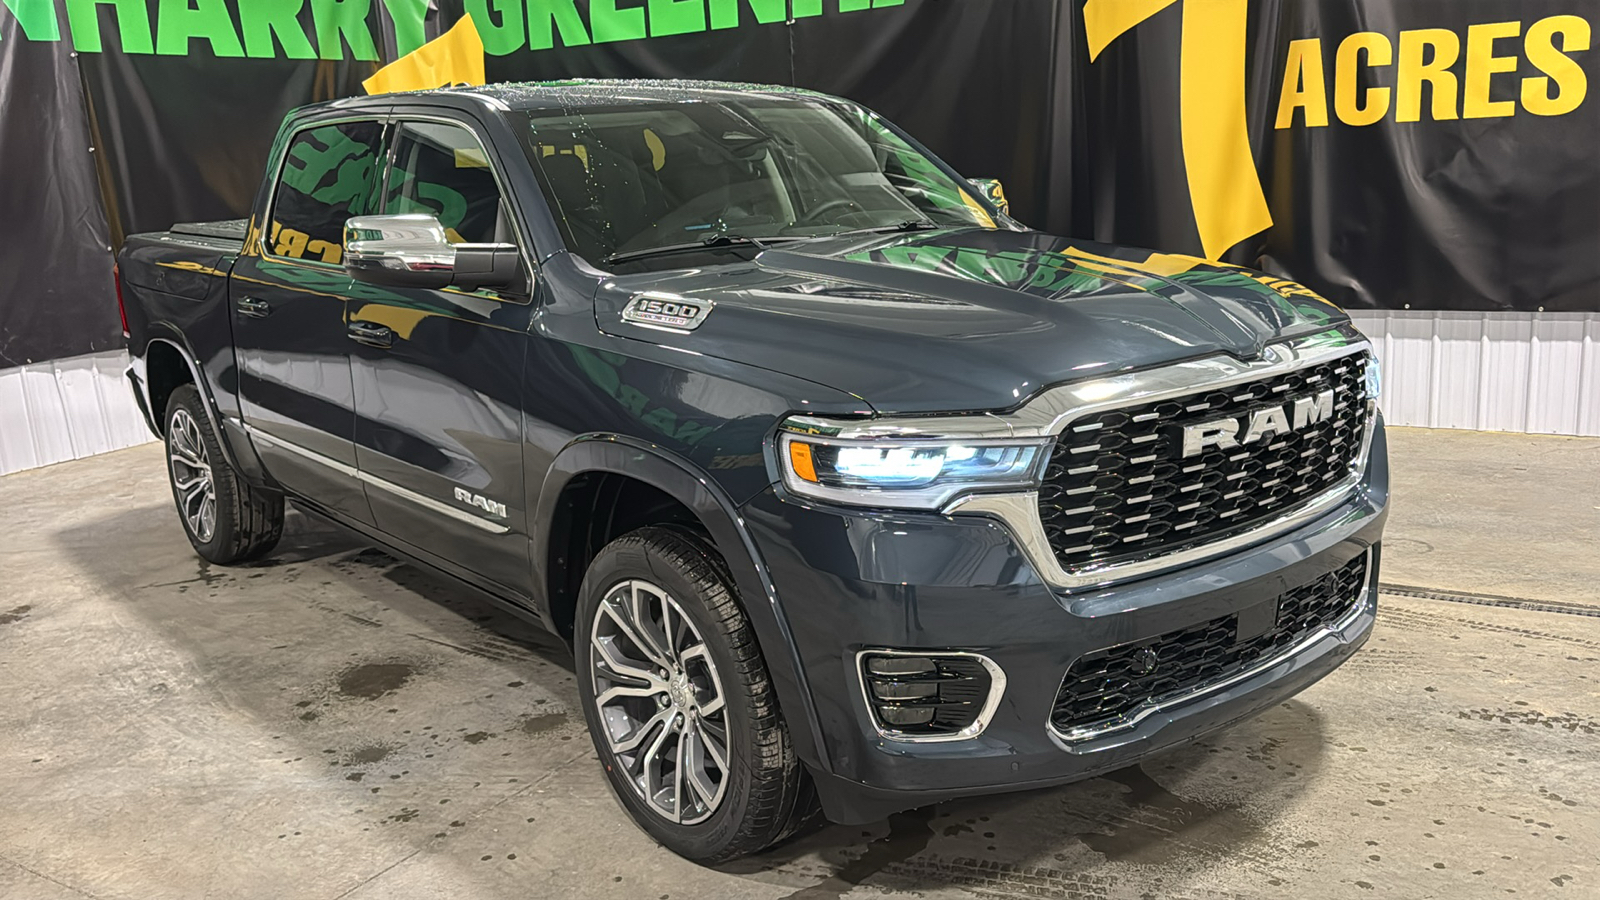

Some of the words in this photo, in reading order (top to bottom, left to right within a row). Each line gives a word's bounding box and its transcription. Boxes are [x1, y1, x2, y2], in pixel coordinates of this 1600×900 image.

[1274, 15, 1591, 129] ACRES
[638, 299, 698, 319] 1500
[1182, 388, 1334, 459] RAM
[454, 486, 507, 518] RAM
